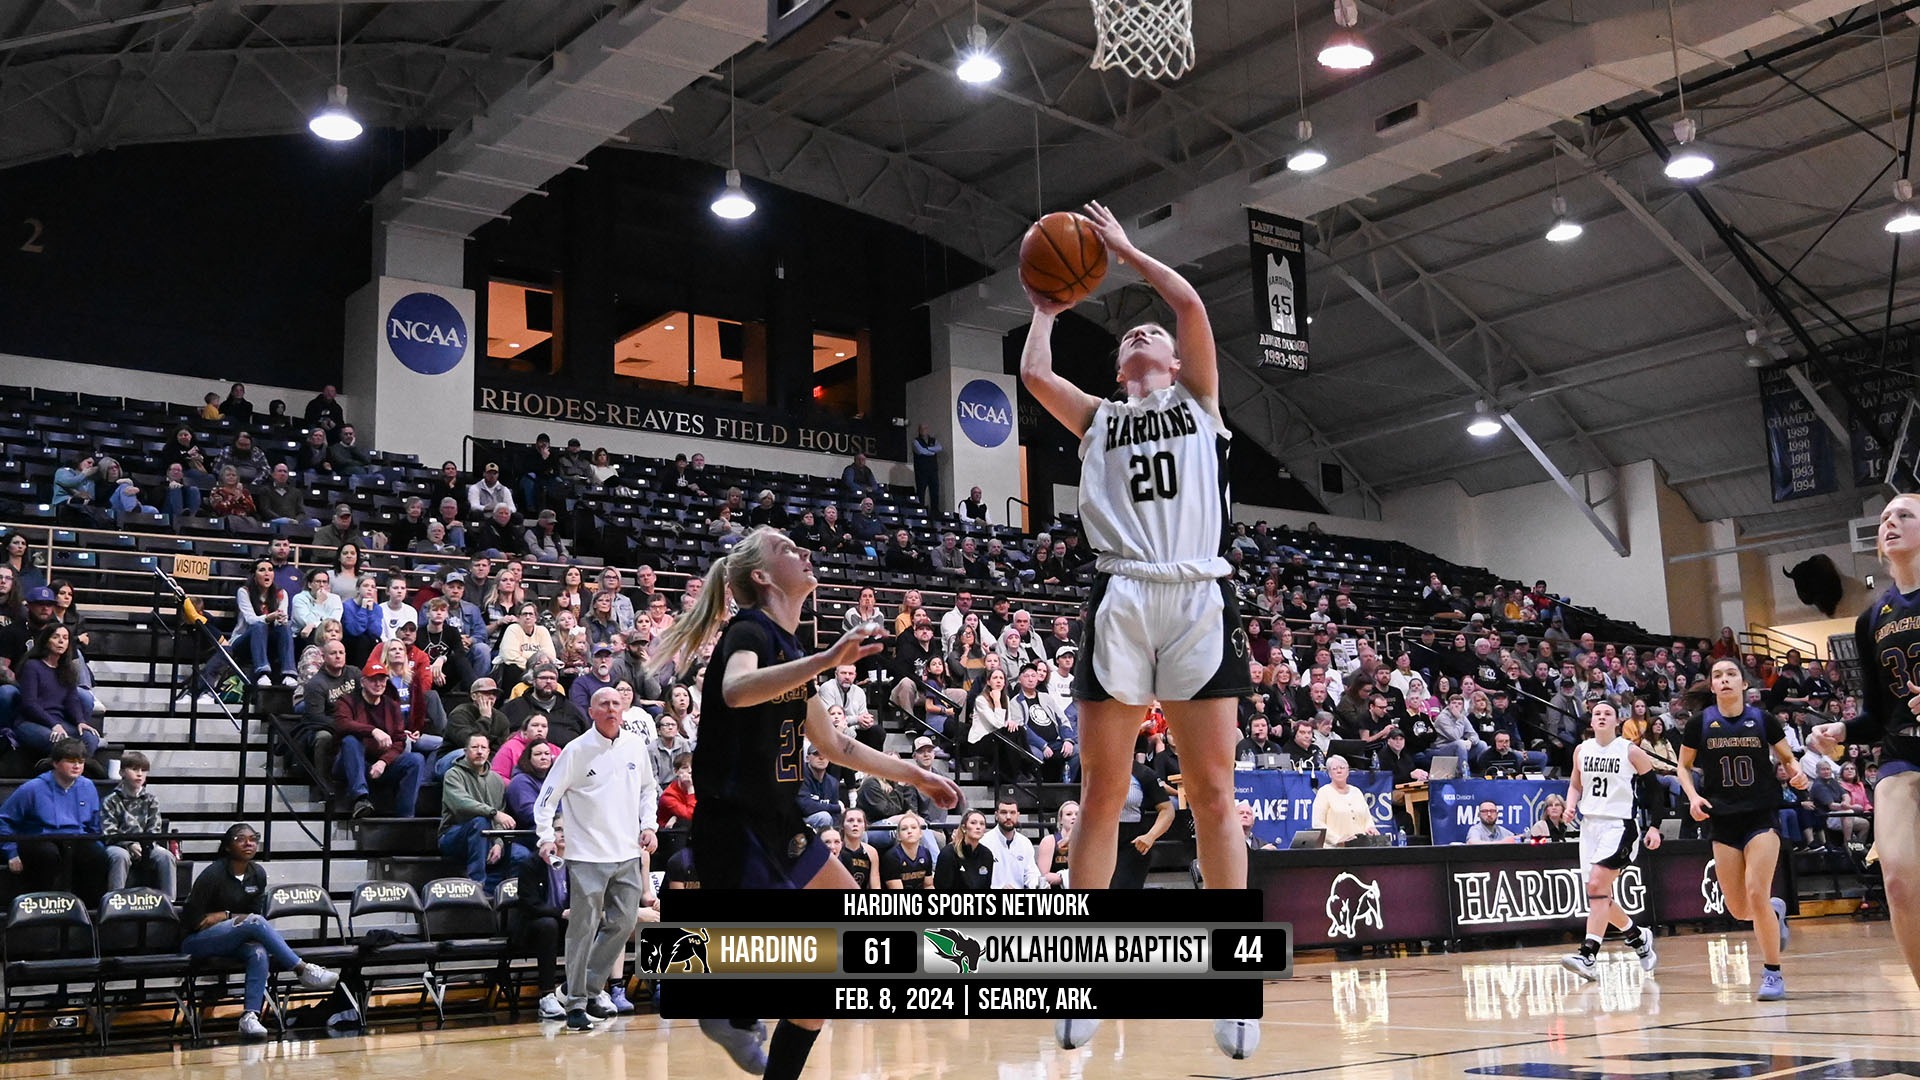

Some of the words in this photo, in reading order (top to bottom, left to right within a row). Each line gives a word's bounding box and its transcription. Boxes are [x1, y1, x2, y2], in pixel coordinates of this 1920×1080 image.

[20, 218, 44, 254] 2
[1271, 294, 1291, 315] 45
[391, 318, 462, 348] NCAA
[481, 387, 704, 435] RHODES-REAVES
[715, 417, 788, 445] FIELD
[799, 428, 877, 456] HOUSE
[960, 401, 1010, 425] NCAA
[1767, 411, 1817, 429] CHAMPIO
[1106, 402, 1197, 451] HARDING
[1129, 451, 1177, 502] 20
[1793, 478, 1815, 492] 1994
[176, 559, 208, 575] VISITOR
[776, 719, 806, 782] 2
[1584, 755, 1621, 774] HARDING
[1720, 755, 1755, 787] 10
[1592, 776, 1608, 798] 21
[1294, 798, 1312, 820] IT
[1457, 804, 1503, 826] MAE
[1508, 804, 1523, 825] IT
[127, 894, 163, 907] Unity
[290, 888, 321, 902] Unity
[377, 885, 409, 899] Unity
[447, 883, 475, 896] Unity
[1454, 865, 1647, 925] HARDIG
[39, 896, 75, 910] Unity
